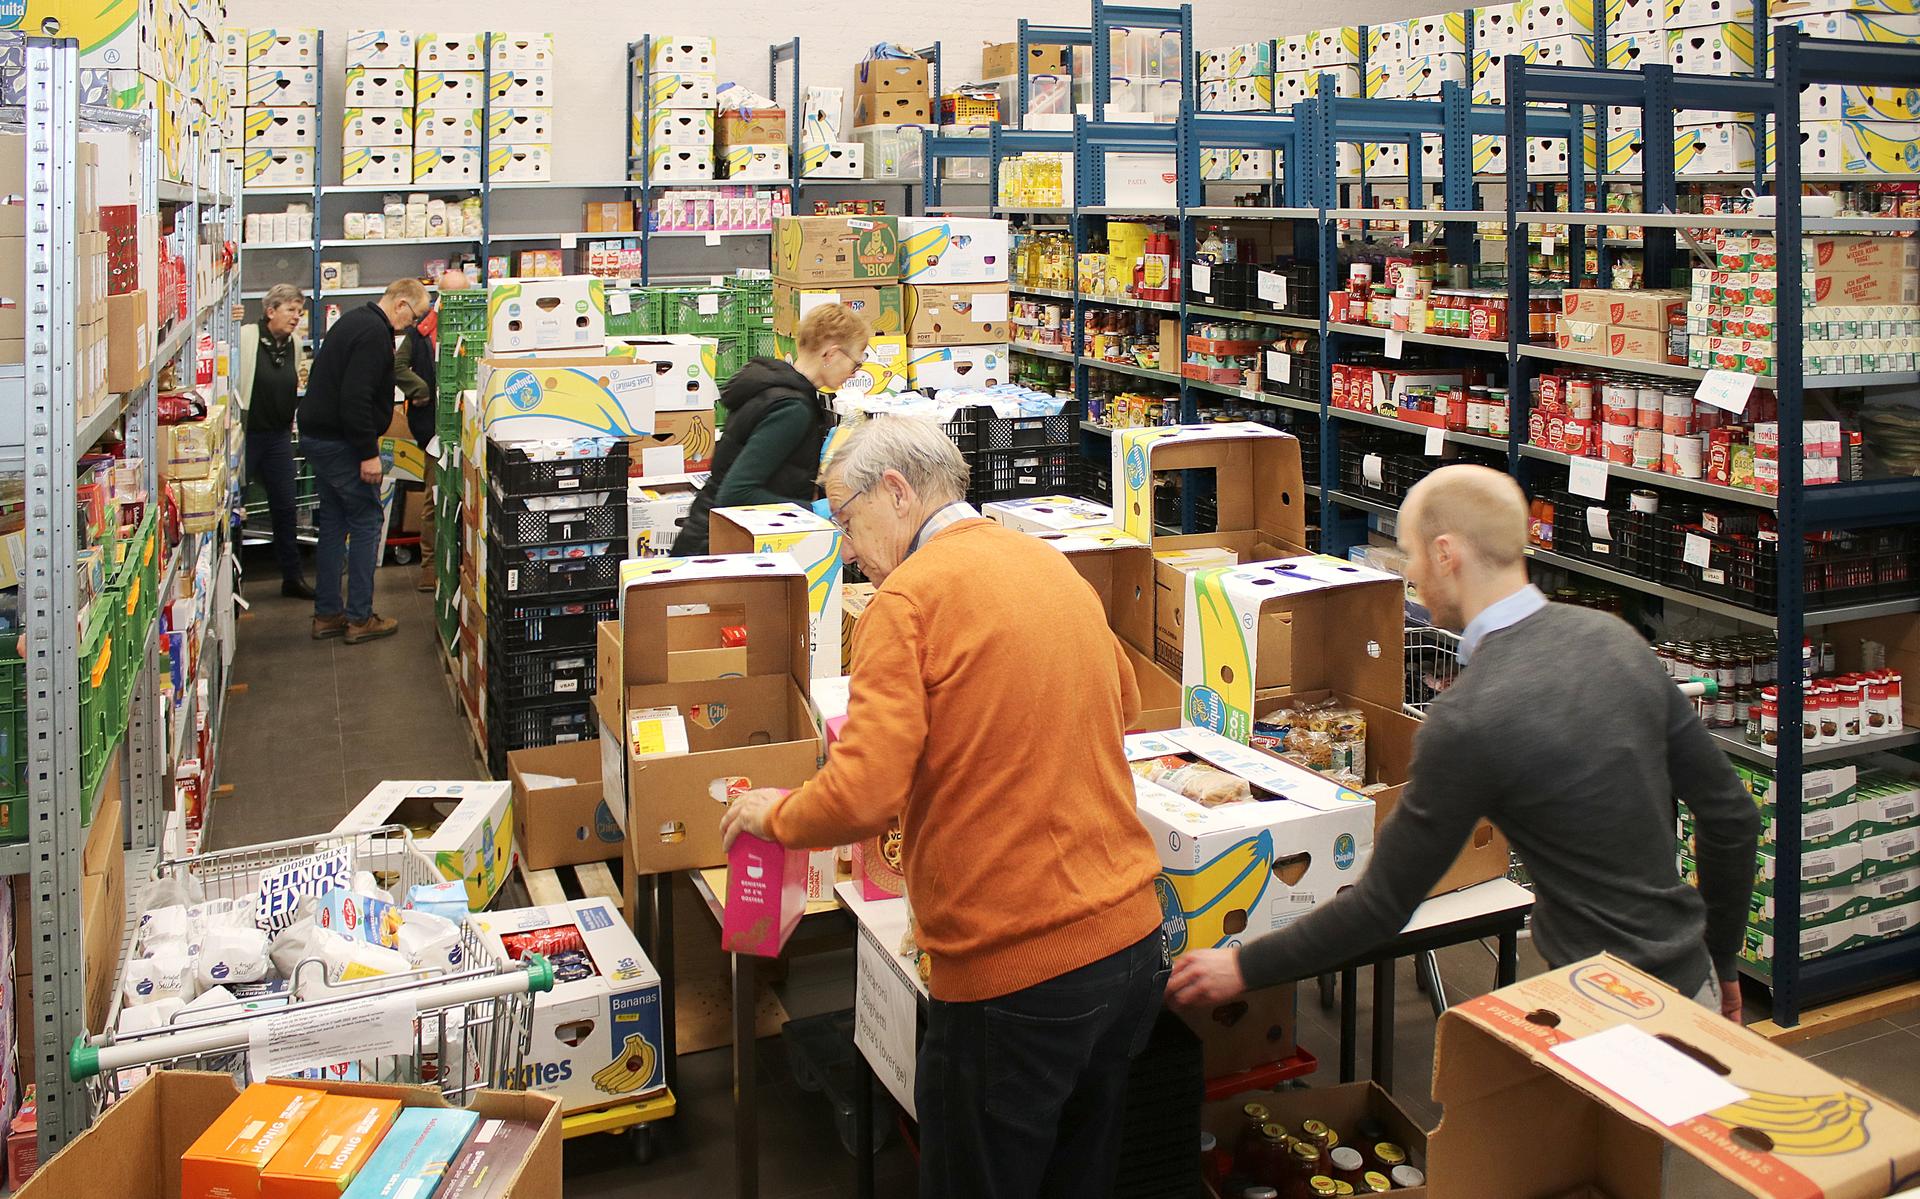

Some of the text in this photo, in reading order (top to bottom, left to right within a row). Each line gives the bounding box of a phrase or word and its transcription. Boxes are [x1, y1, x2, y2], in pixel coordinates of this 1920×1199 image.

[867, 264, 889, 276] BIO
[506, 374, 537, 396] Chiquita
[259, 854, 351, 899] KLONTEN
[279, 846, 348, 875] EXTRA GROOT
[612, 992, 657, 1011] Bananas
[1588, 972, 1655, 1010] Dole
[1487, 1005, 1546, 1041] PREMIUM
[251, 1122, 285, 1154] HONIG
[329, 1135, 362, 1170] HONIG
[1692, 1123, 1773, 1176] BANANAS
